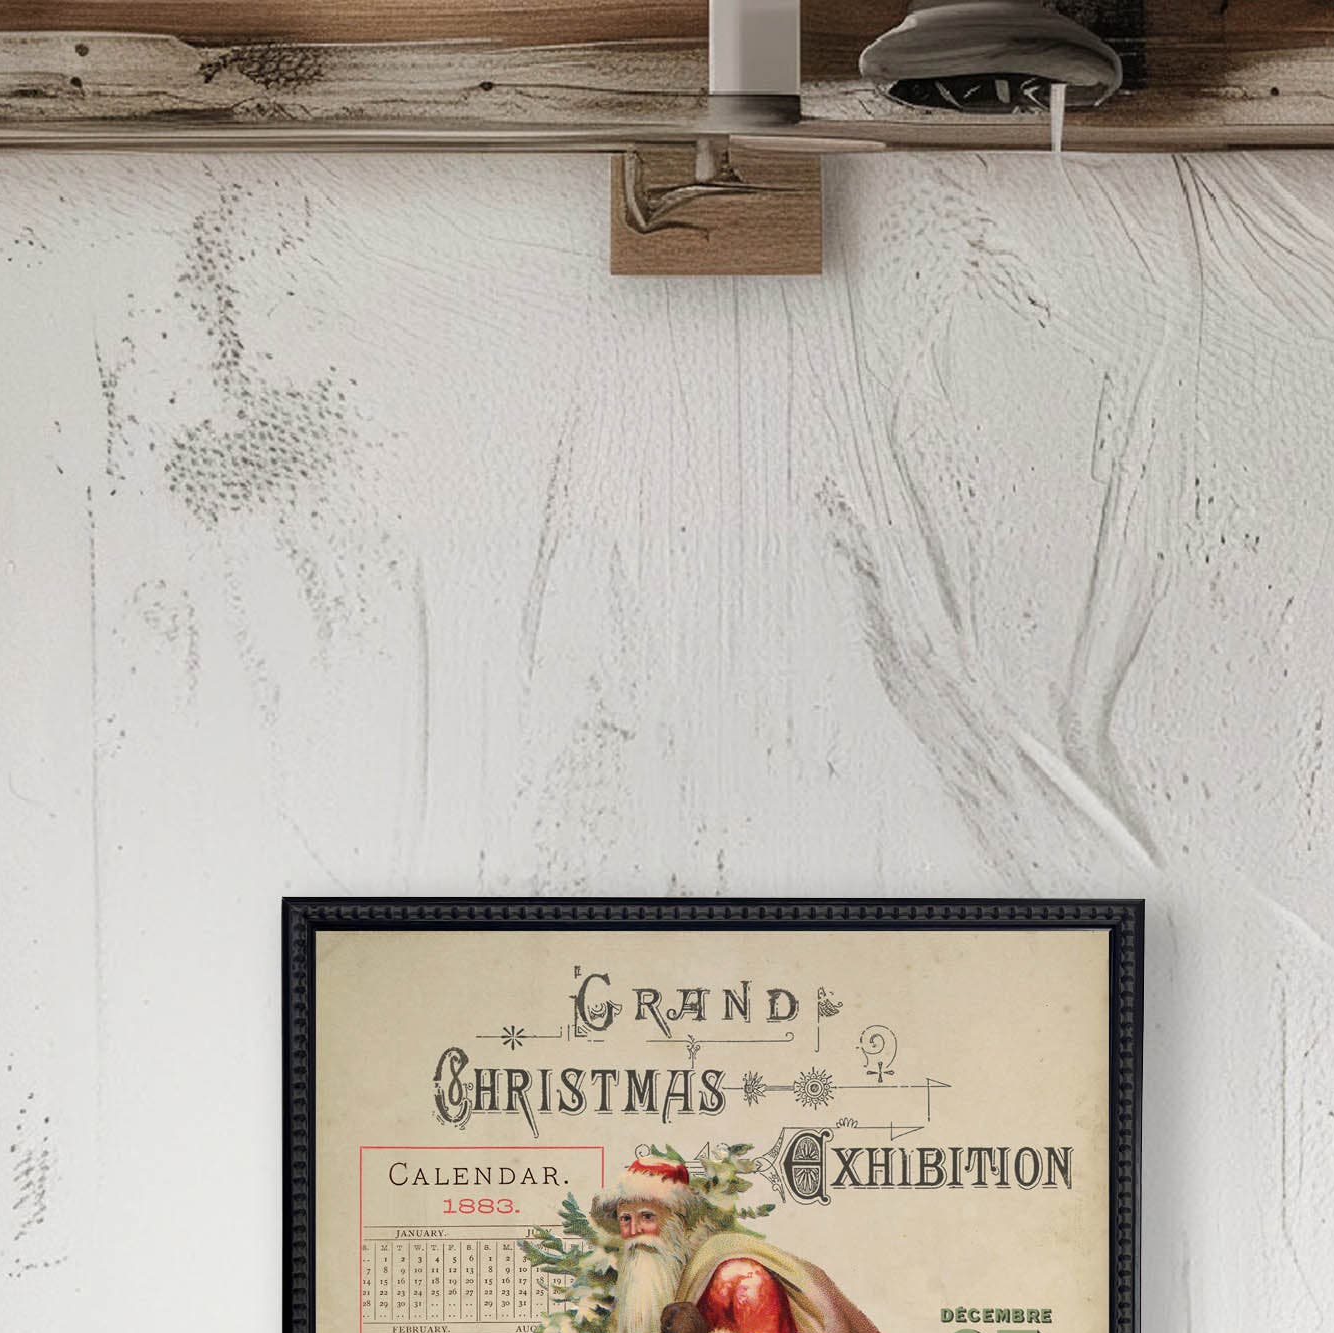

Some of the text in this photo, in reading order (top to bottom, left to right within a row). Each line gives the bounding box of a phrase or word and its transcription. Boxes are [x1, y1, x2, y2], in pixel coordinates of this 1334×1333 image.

[570, 973, 801, 1039] GRAND
[434, 1046, 728, 1138] CHRISTMAS
[388, 1162, 570, 1187] CALENDAR.
[779, 1127, 1074, 1205] EXHIBITION
[442, 1198, 521, 1214] 1883.
[395, 1229, 447, 1239] JANUARY.
[940, 1306, 1053, 1324] DÉCEMBRE
[392, 1325, 451, 1333] FEBRUARY.
